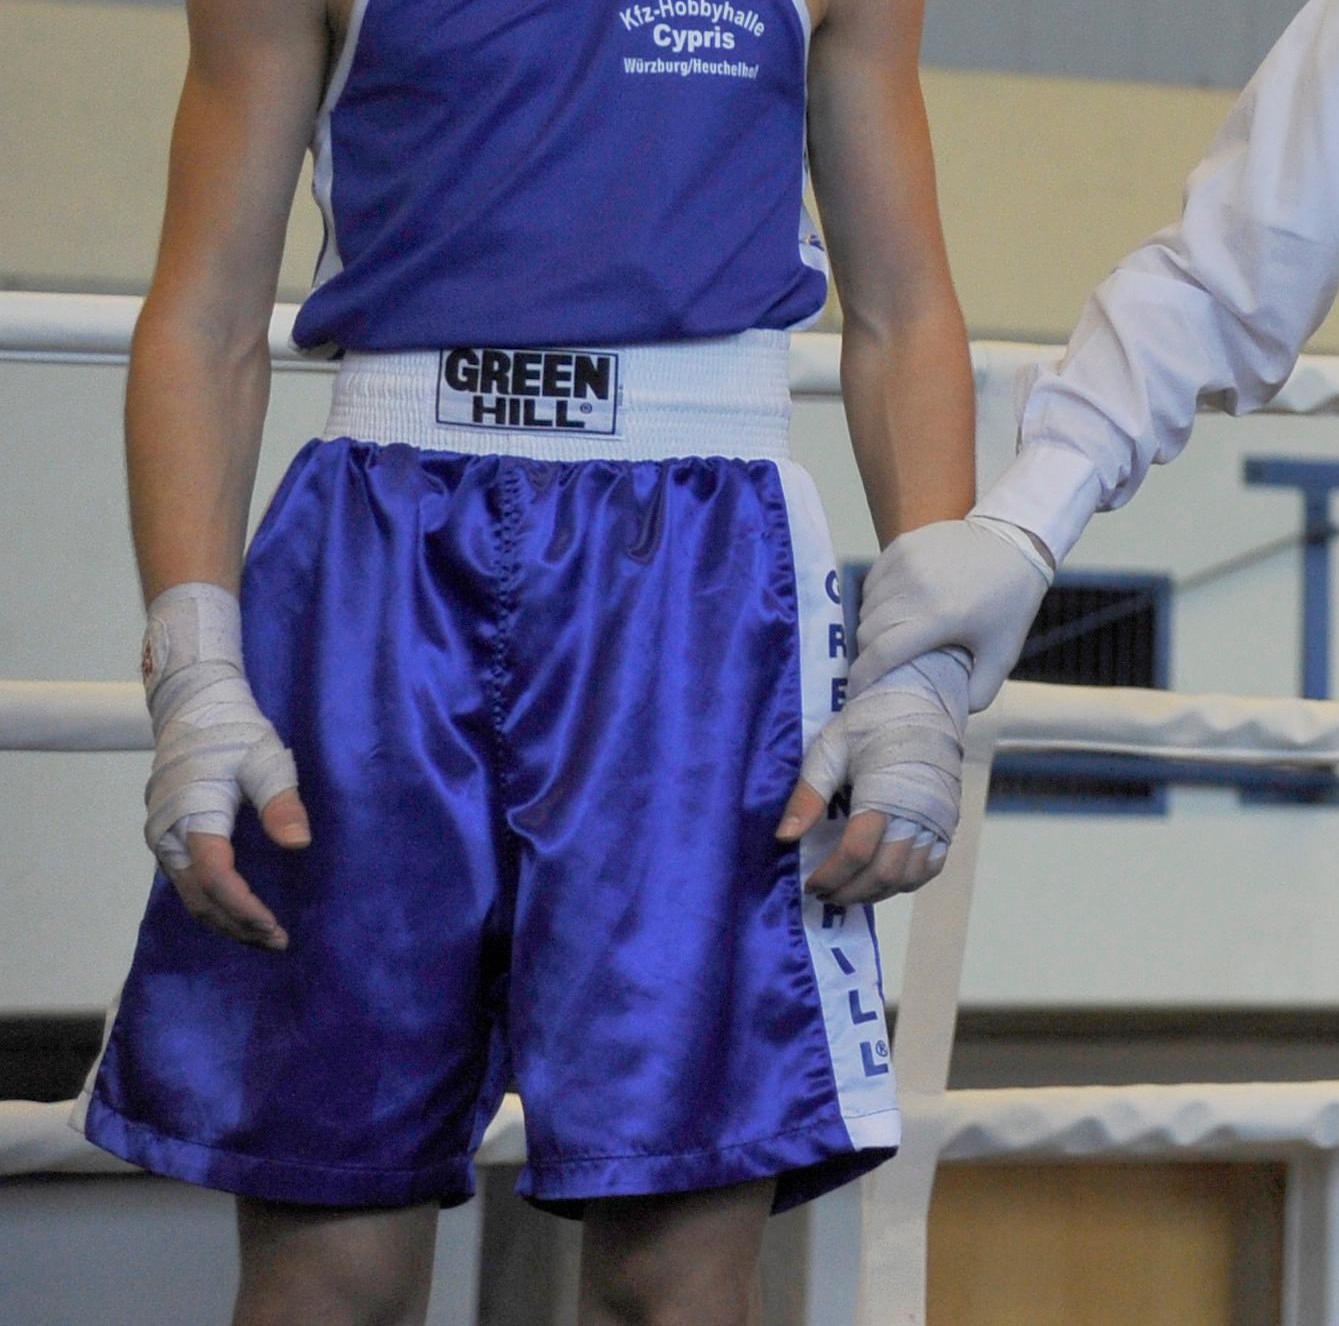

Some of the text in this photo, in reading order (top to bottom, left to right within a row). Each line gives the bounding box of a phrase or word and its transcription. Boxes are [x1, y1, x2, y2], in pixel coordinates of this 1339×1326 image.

[653, 23, 735, 53] Cypris
[444, 347, 611, 400] GREEN
[472, 395, 586, 429] HILL
[825, 569, 852, 820] GREN
